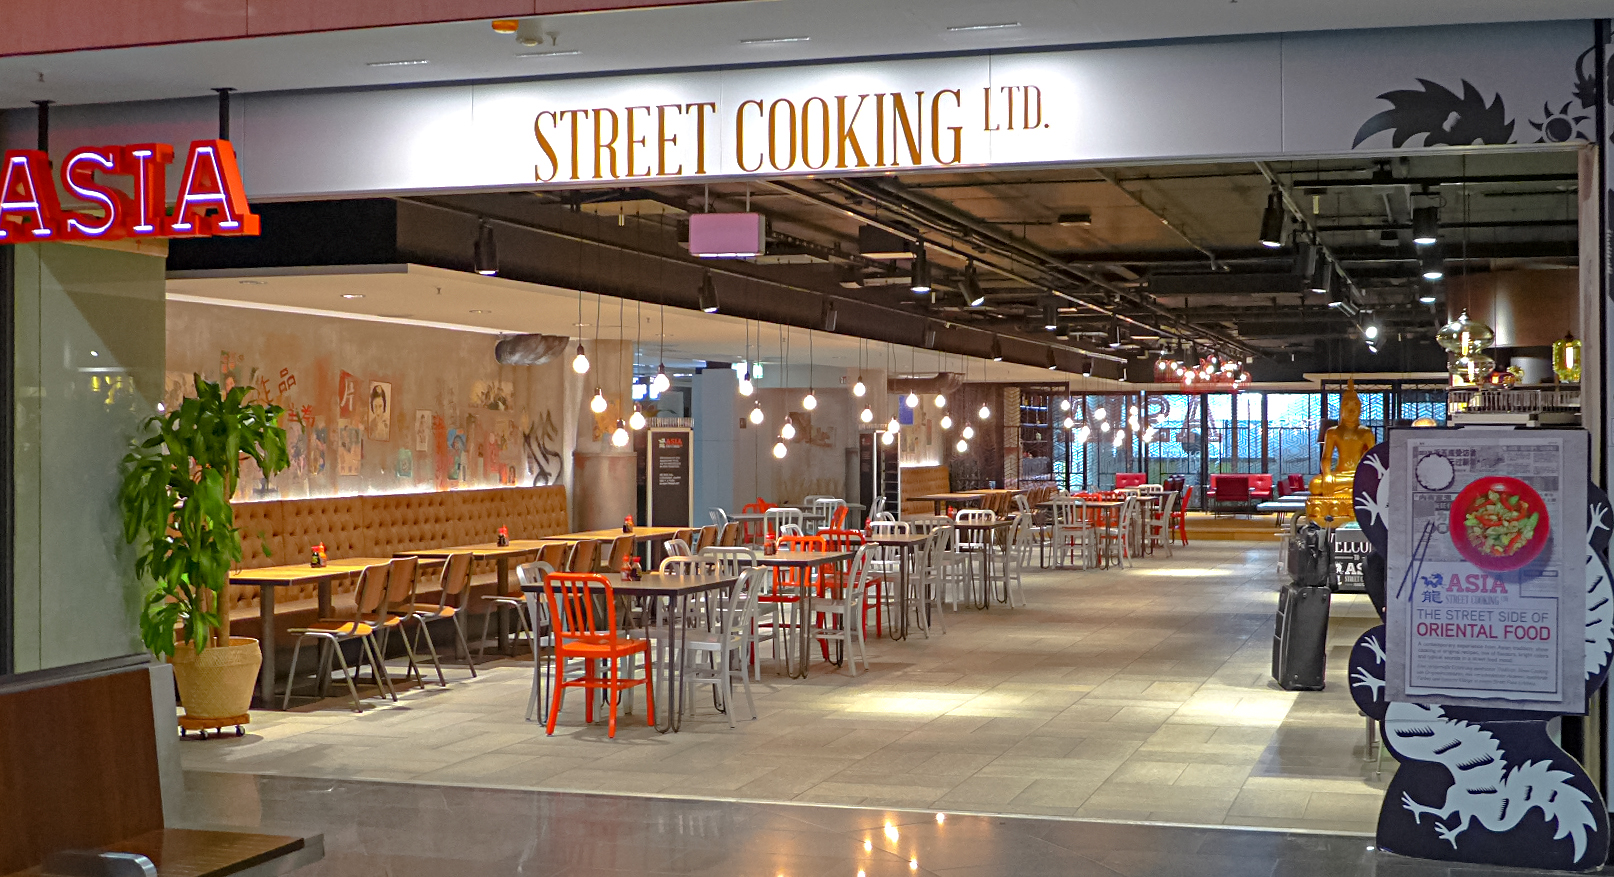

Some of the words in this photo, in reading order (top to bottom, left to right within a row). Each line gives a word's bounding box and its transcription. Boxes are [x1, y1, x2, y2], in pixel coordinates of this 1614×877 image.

[534, 102, 716, 182] STREET
[736, 89, 963, 172] COOKING
[983, 85, 1050, 131] LTD.
[0, 140, 258, 242] ASIA
[1446, 573, 1508, 594] ASIA
[1445, 594, 1469, 605] STREET
[1416, 609, 1442, 620] THE
[1445, 610, 1494, 622] STREET
[1498, 611, 1528, 623] SIDE
[1531, 612, 1549, 623] OF
[1416, 622, 1498, 639] ORIENTAL
[1504, 625, 1551, 641] FOOD
